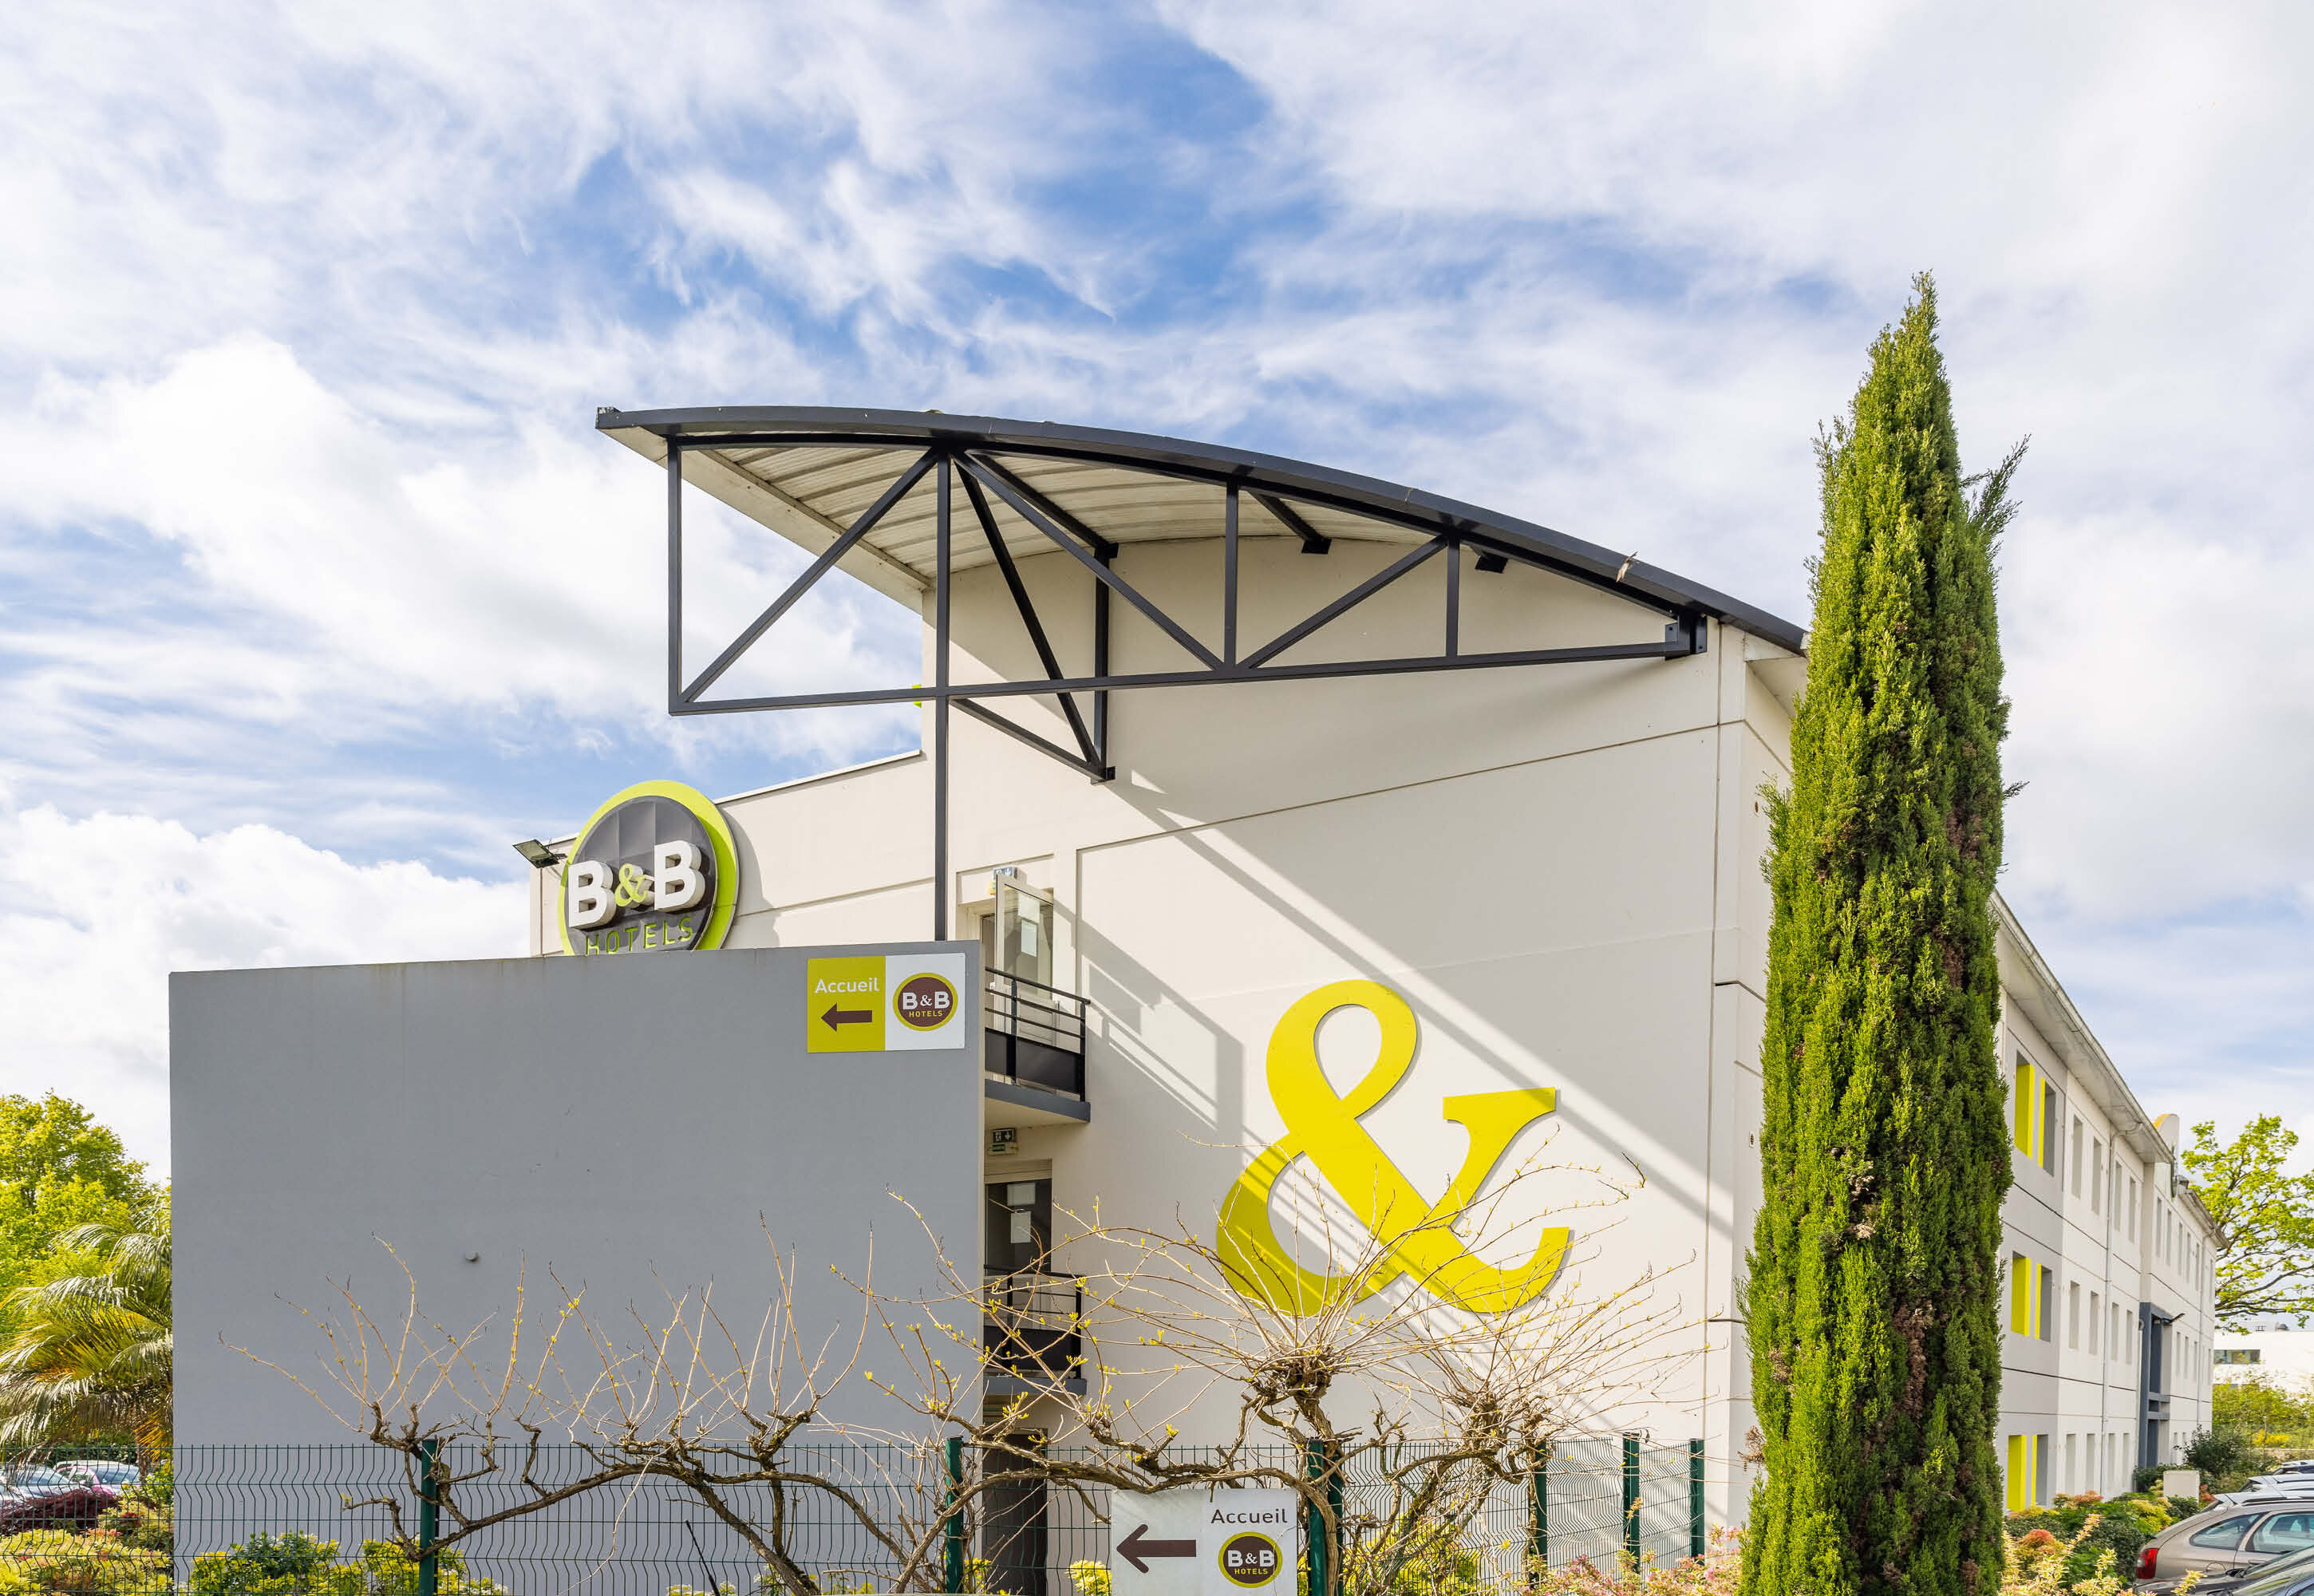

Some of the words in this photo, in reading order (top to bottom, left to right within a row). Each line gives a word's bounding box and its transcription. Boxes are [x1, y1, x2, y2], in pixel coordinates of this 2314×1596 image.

[568, 840, 705, 929] B&B
[585, 916, 693, 957] HOTELS
[814, 977, 880, 994] Accueil
[902, 990, 950, 1010] B&B
[1210, 1508, 1288, 1524] Accueil
[1227, 1550, 1274, 1567] B&B
